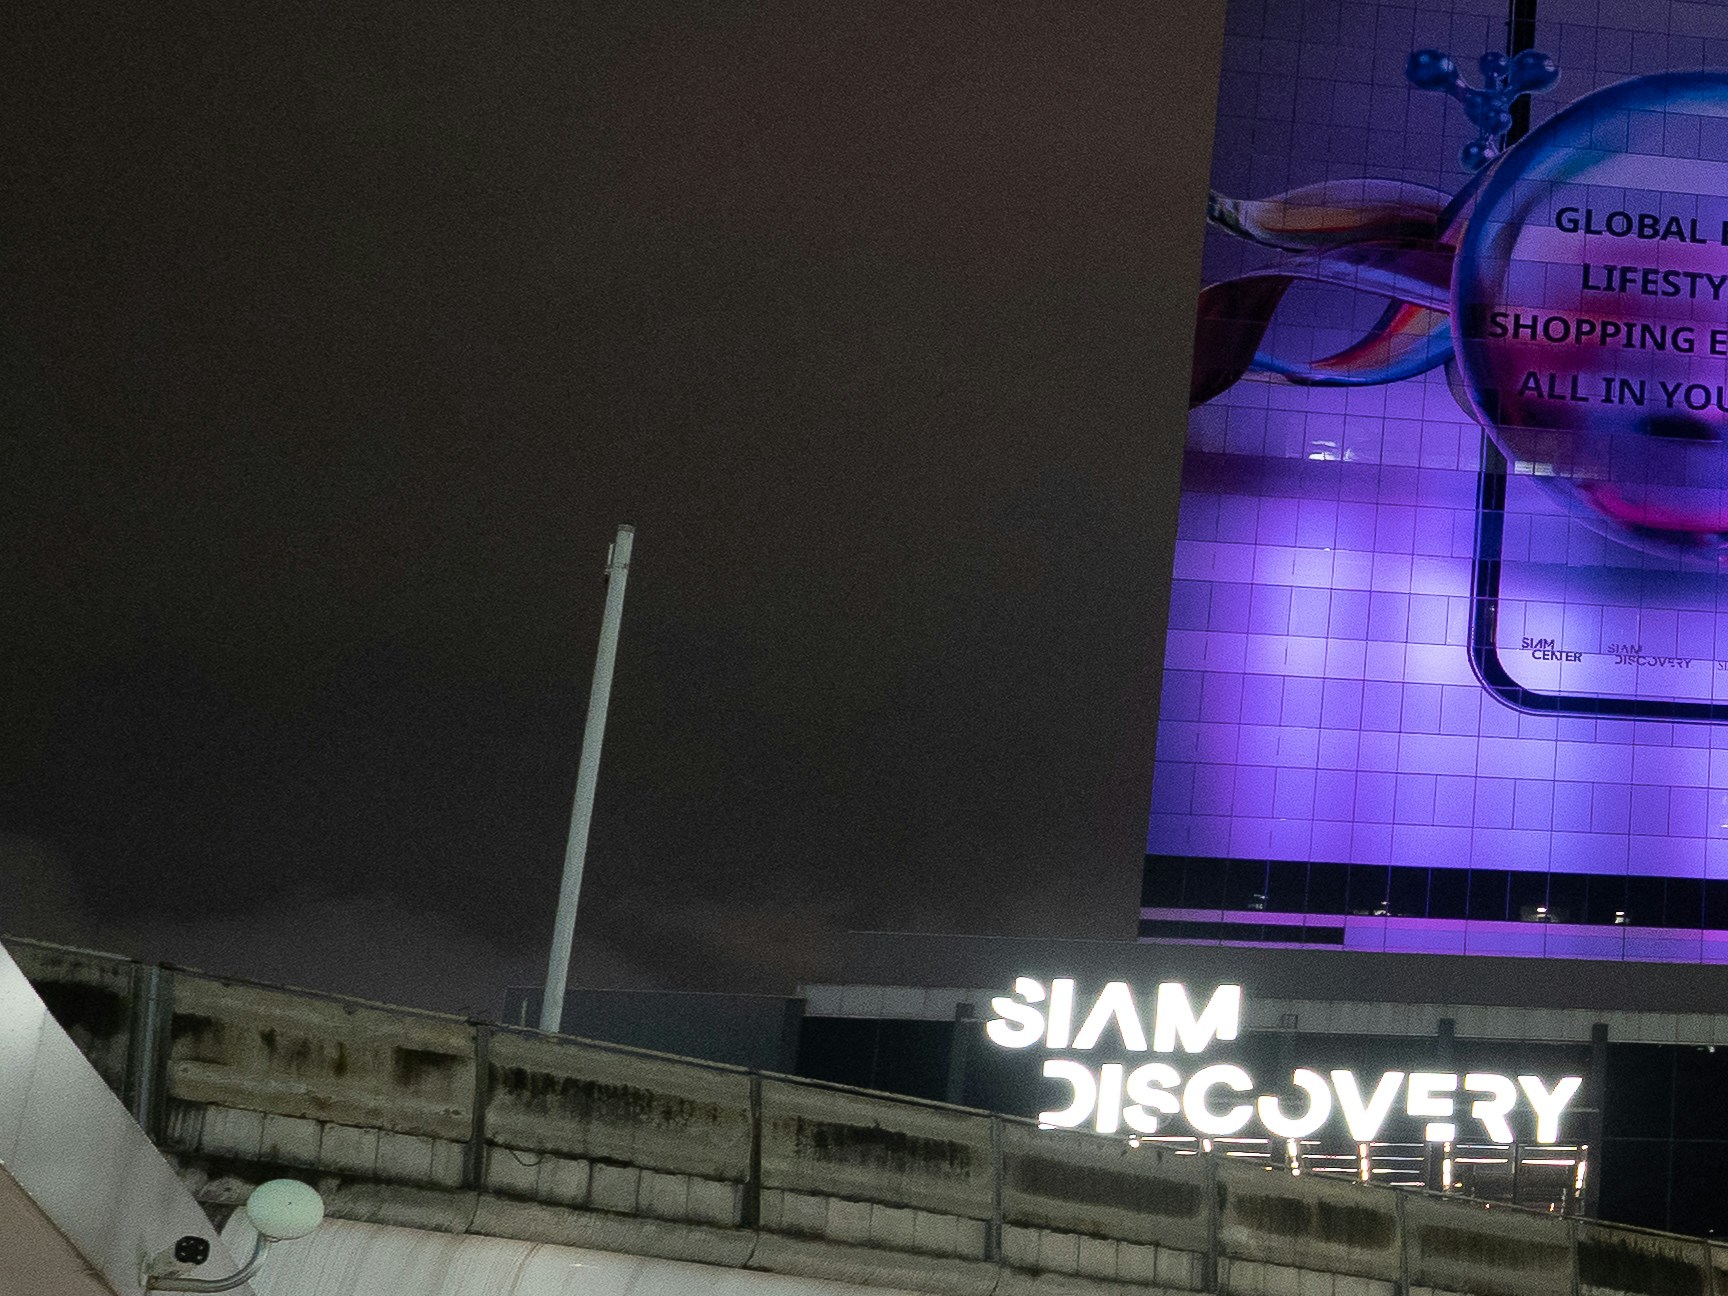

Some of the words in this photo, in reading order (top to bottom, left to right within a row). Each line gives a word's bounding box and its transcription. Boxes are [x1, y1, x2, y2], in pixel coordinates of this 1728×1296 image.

[1554, 206, 1706, 245] GLOBAL
[1487, 310, 1695, 355] SHOPPING
[1517, 371, 1590, 403] ALL
[1602, 377, 1647, 407] IN
[1521, 637, 1555, 650] SIAM
[1531, 649, 1583, 663] CENTER
[1614, 654, 1692, 669] DISCOVERY
[986, 976, 1243, 1053] SIAM
[1037, 1059, 1584, 1144] DISCOVERY
